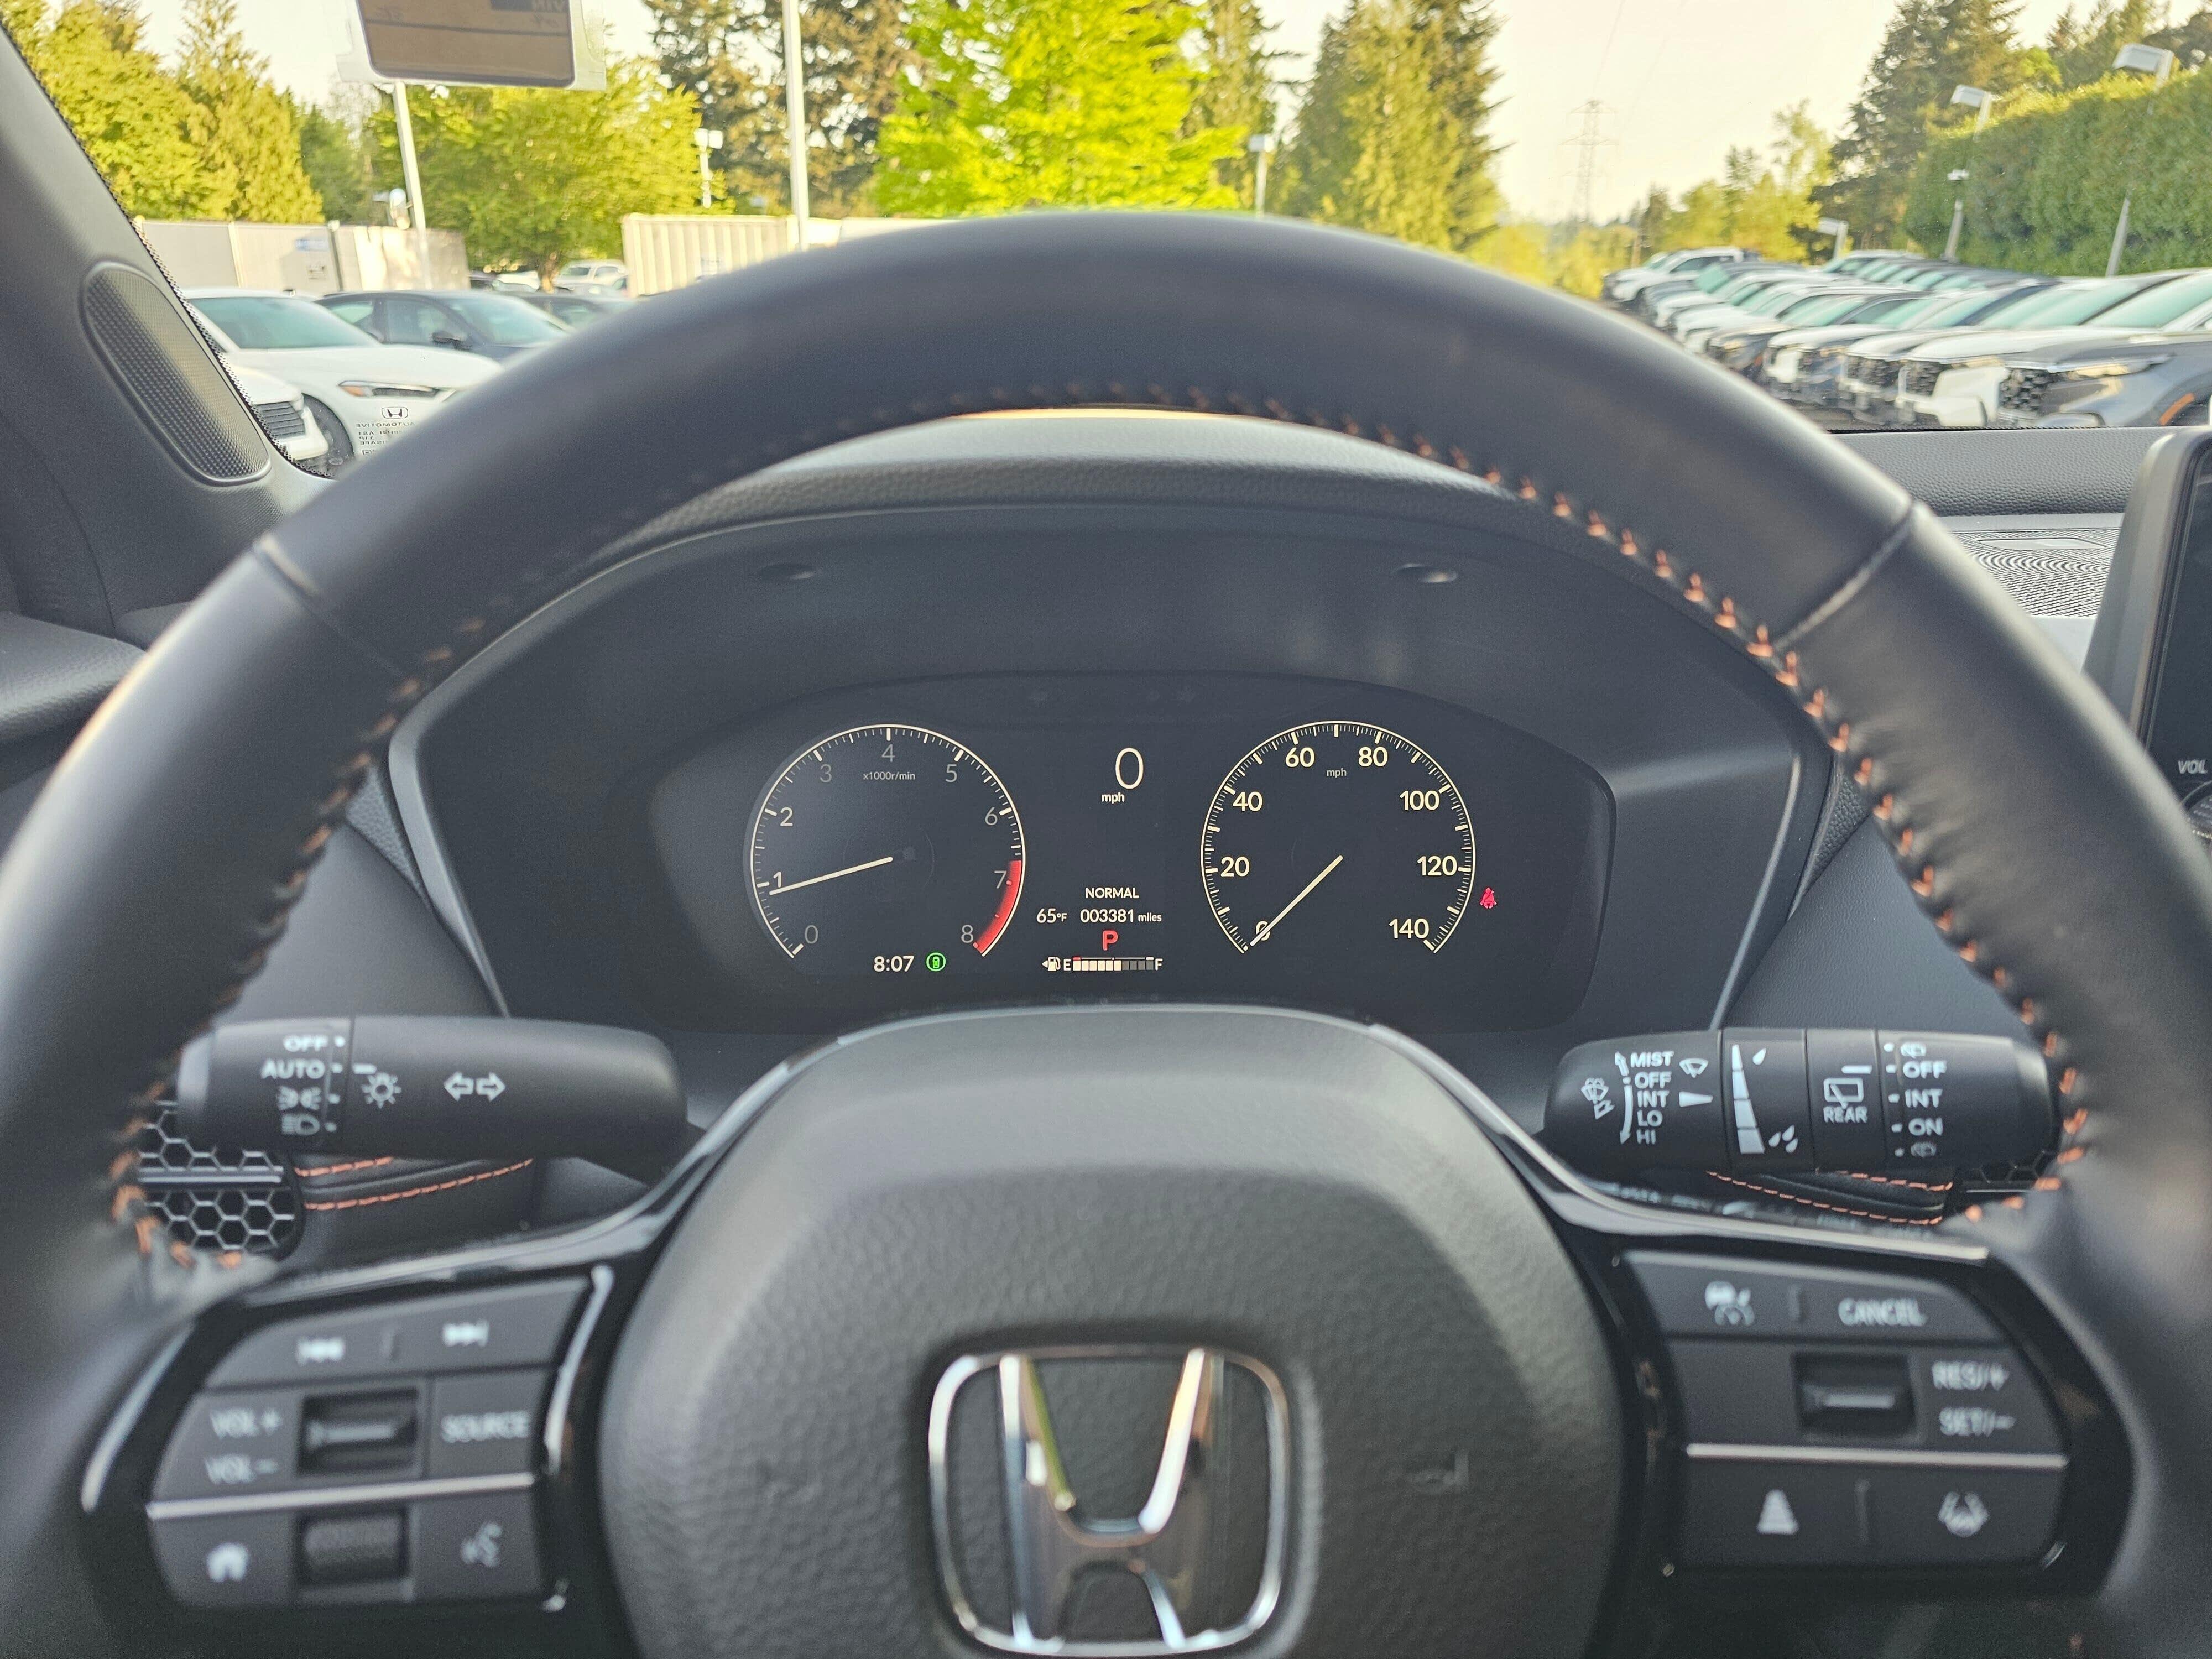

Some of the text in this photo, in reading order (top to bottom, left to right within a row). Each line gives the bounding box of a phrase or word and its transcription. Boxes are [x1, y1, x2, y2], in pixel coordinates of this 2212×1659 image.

[881, 744, 895, 763] 4
[1285, 747, 1315, 768] 60
[1358, 747, 1389, 768] 80
[820, 764, 832, 782] 3
[863, 771, 915, 780] x1000r/min
[945, 764, 957, 782] 5
[1115, 748, 1144, 789] 0
[1327, 768, 1347, 778] mph
[2178, 759, 2208, 775] VOL
[1101, 791, 1125, 804] mph
[1233, 791, 1263, 812] 40
[1399, 790, 1439, 811] 100
[780, 807, 793, 826] 2
[985, 807, 998, 826] 6
[1220, 857, 1250, 877] 20
[1417, 855, 1457, 876] 120
[773, 871, 782, 888] 1
[994, 870, 1006, 889] 7
[1086, 888, 1139, 899] NORMAL
[1080, 909, 1162, 923] 003381 miles
[805, 925, 818, 944] 0
[961, 925, 974, 943] 8
[1256, 921, 1270, 941] 0
[1389, 919, 1430, 939] 140
[1102, 930, 1119, 951] P
[873, 956, 915, 972] 8:07
[1063, 958, 1071, 971] E
[1155, 958, 1163, 971] F
[283, 1035, 329, 1051] OFF
[1630, 1051, 1674, 1067] MIST
[261, 1058, 326, 1079] AUTO
[1902, 1060, 1947, 1078] OFF
[1635, 1071, 1672, 1089] OFF
[1637, 1090, 1670, 1108] INT
[1905, 1089, 1943, 1108] INT
[1637, 1109, 1663, 1127] LO
[1823, 1106, 1868, 1123] REAR
[1908, 1117, 1943, 1136] ON
[1636, 1129, 1657, 1145] HI
[1838, 1298, 1929, 1327] CANCEL
[442, 1411, 530, 1443] SOURCE
